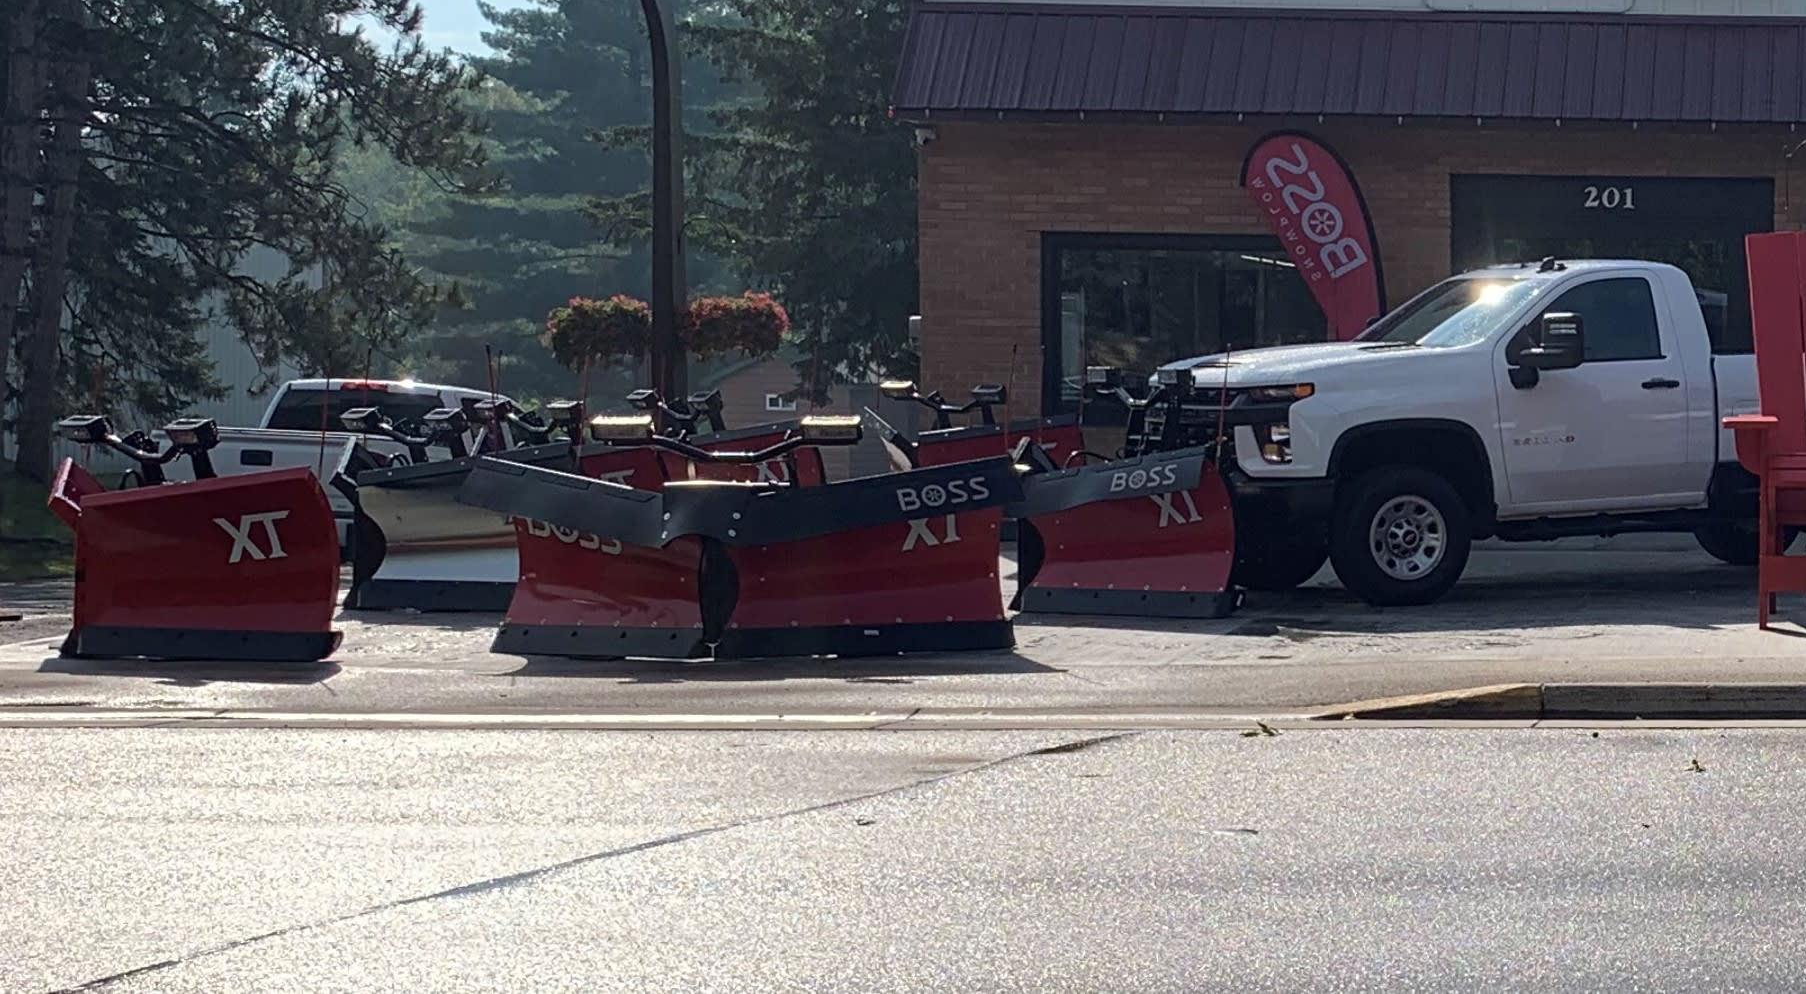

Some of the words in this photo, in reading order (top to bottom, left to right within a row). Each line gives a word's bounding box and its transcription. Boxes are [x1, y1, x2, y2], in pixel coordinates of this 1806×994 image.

[1584, 186, 1635, 209] 201
[1110, 464, 1177, 492] BOSS
[896, 477, 990, 511] BOSS
[211, 510, 291, 563] XT
